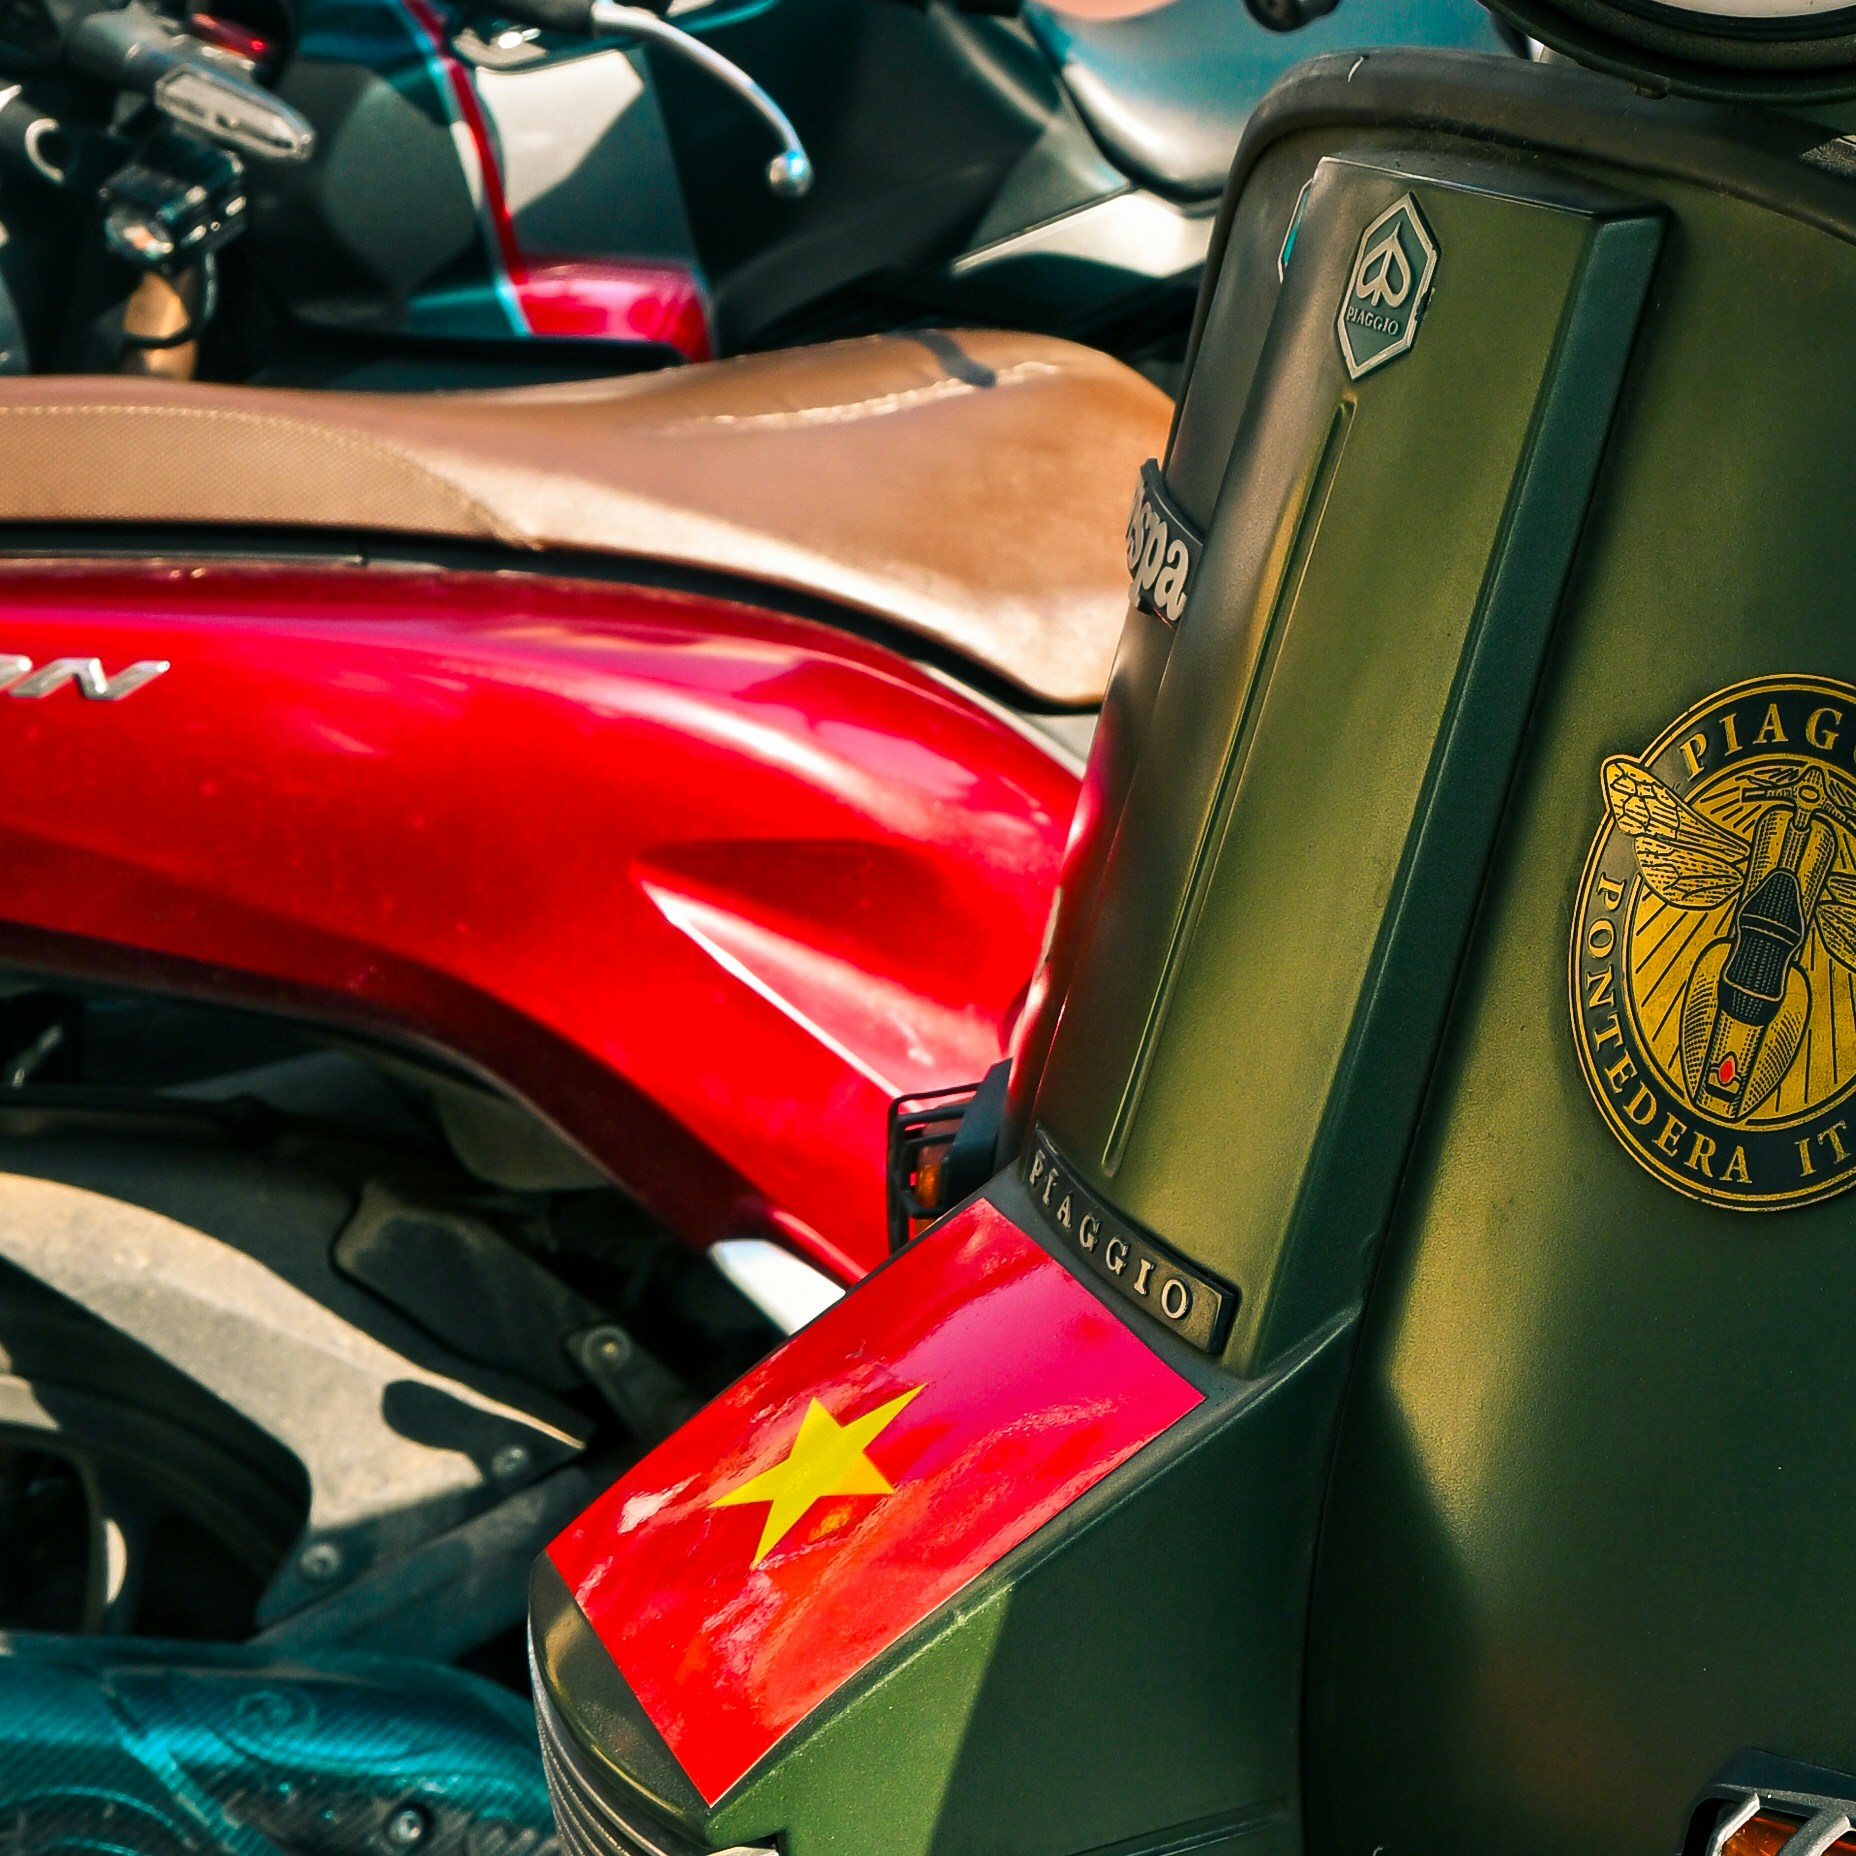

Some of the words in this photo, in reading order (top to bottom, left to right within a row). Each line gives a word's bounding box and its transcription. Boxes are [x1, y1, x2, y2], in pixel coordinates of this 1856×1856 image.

[1346, 305, 1399, 336] PIAGGIO
[1585, 871, 1753, 1185] PONTEDERA
[1028, 1148, 1192, 1320] PIAGGIO
